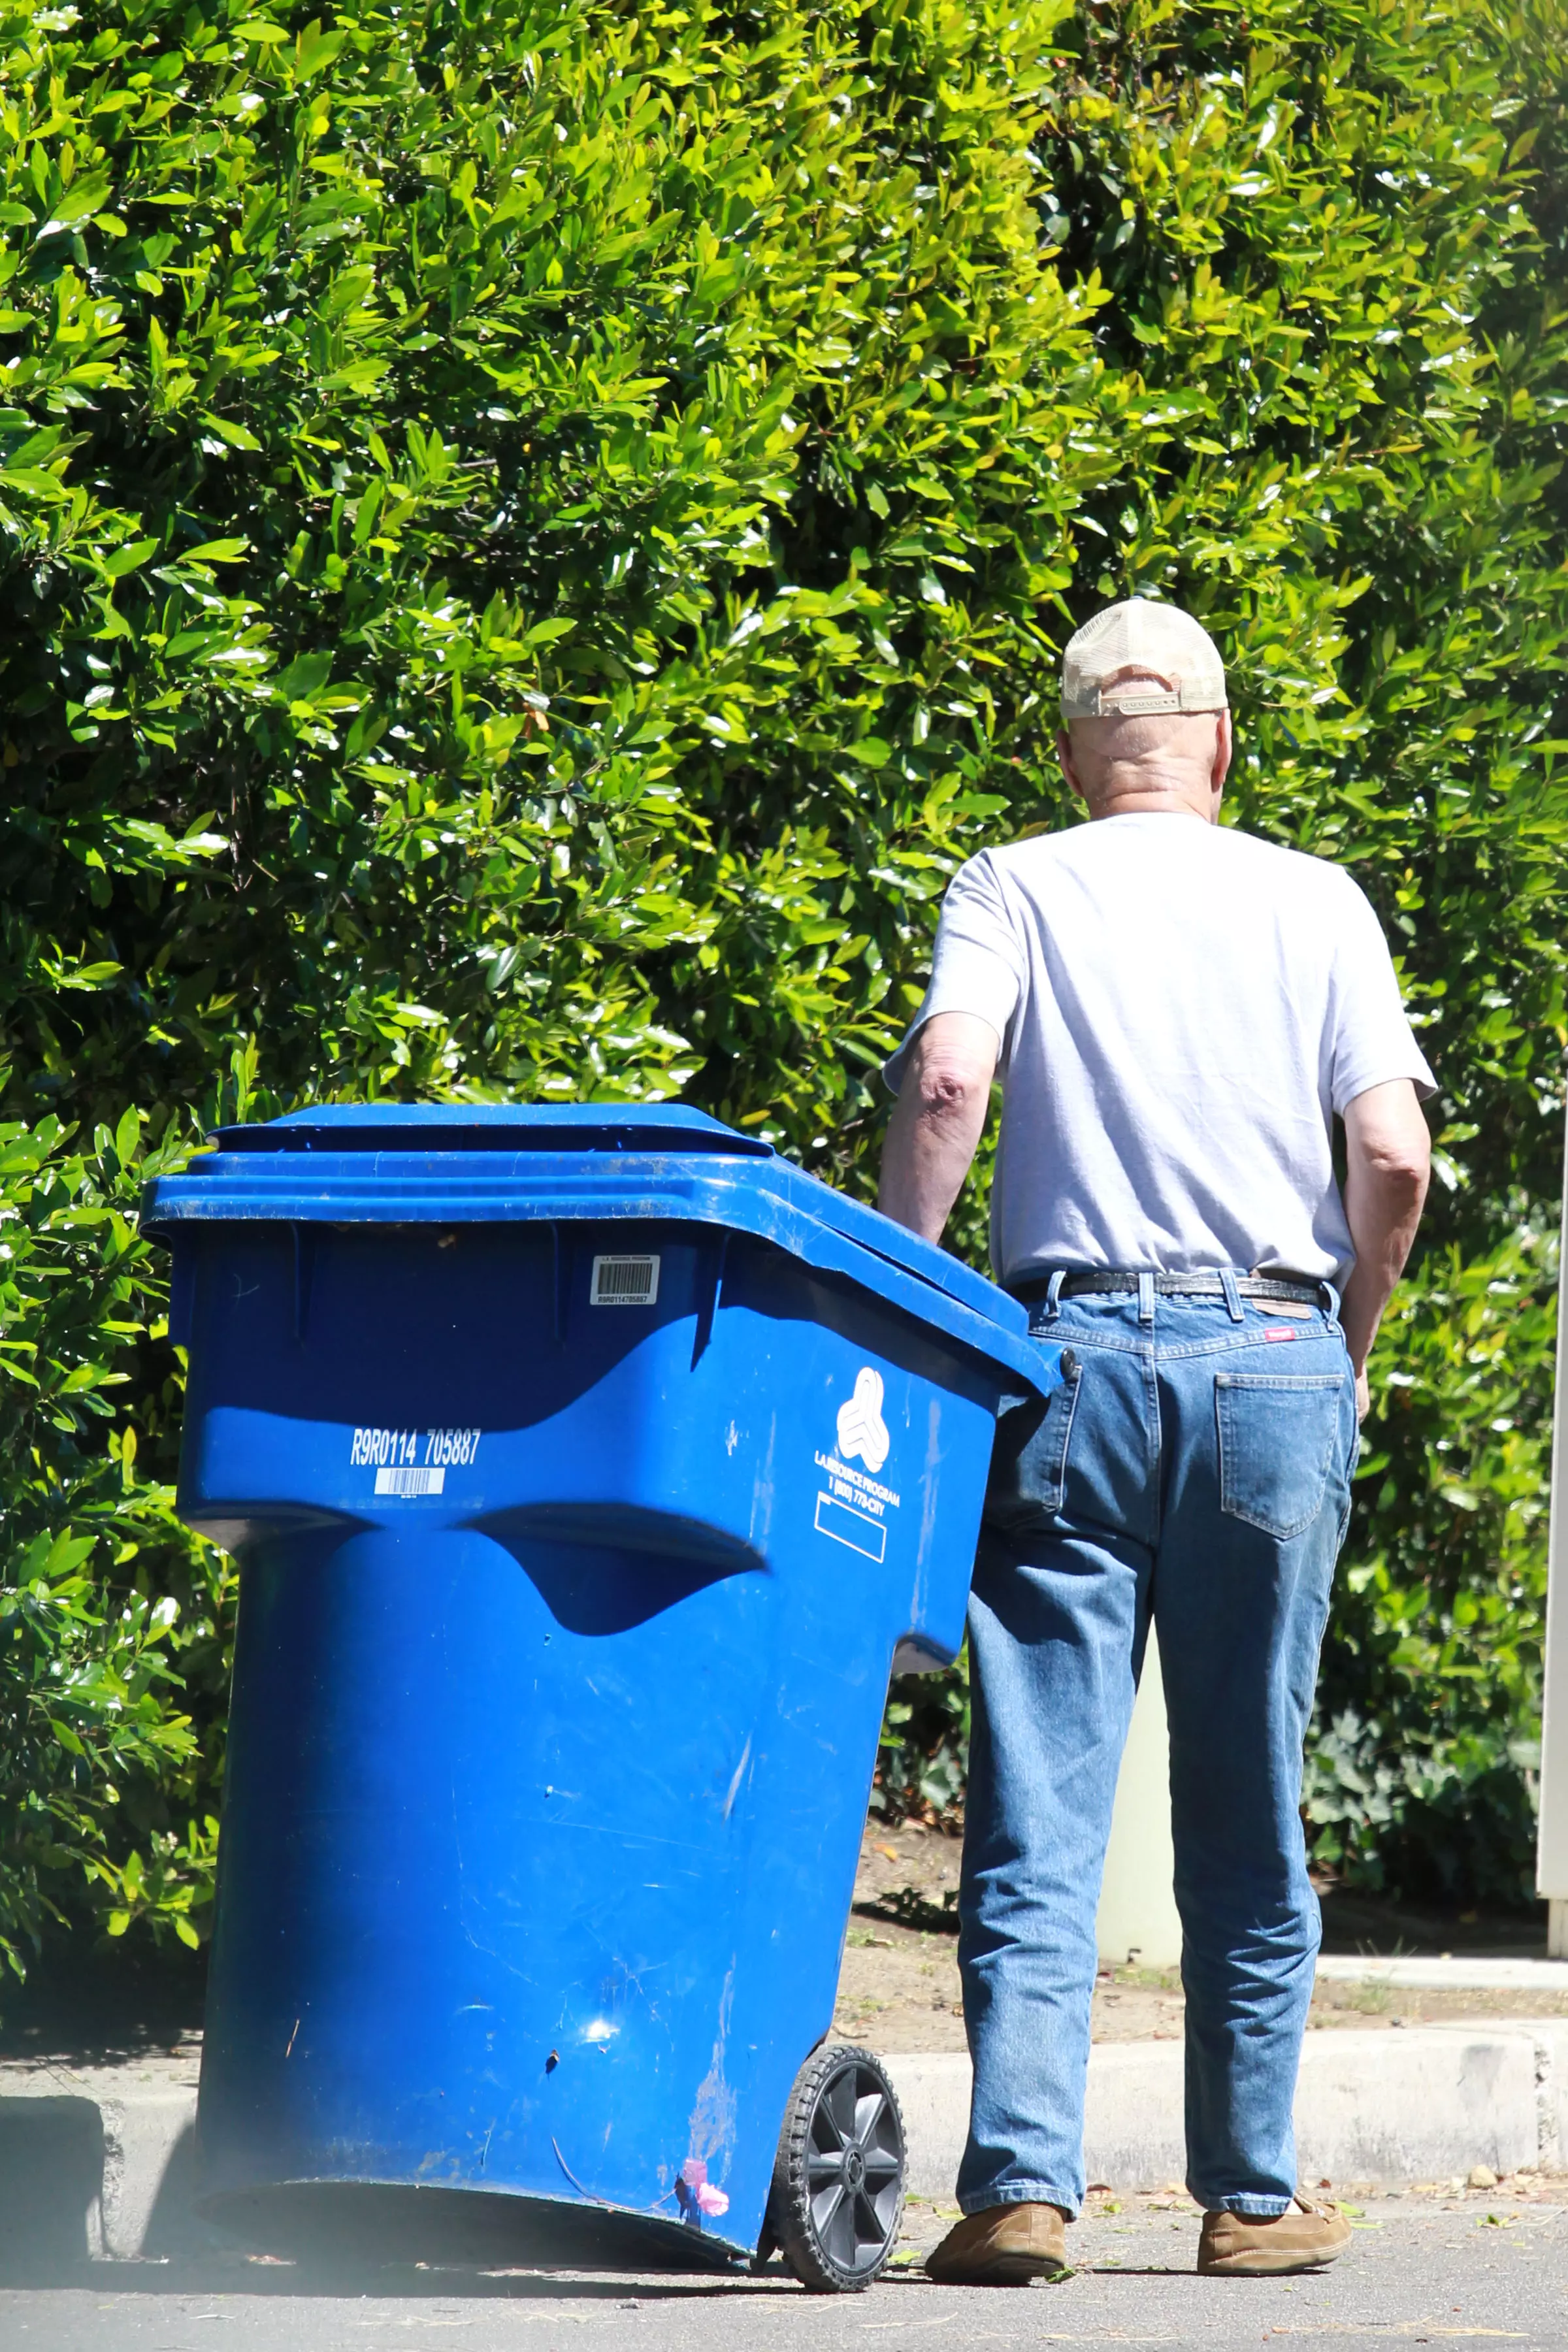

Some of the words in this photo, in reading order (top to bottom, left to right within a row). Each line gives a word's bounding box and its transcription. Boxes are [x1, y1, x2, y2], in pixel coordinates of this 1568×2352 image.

[350, 1428, 417, 1465] R9R0114
[425, 1428, 482, 1465] 705887
[828, 1475, 834, 1490] 1
[863, 1476, 900, 1508] PROGRAM
